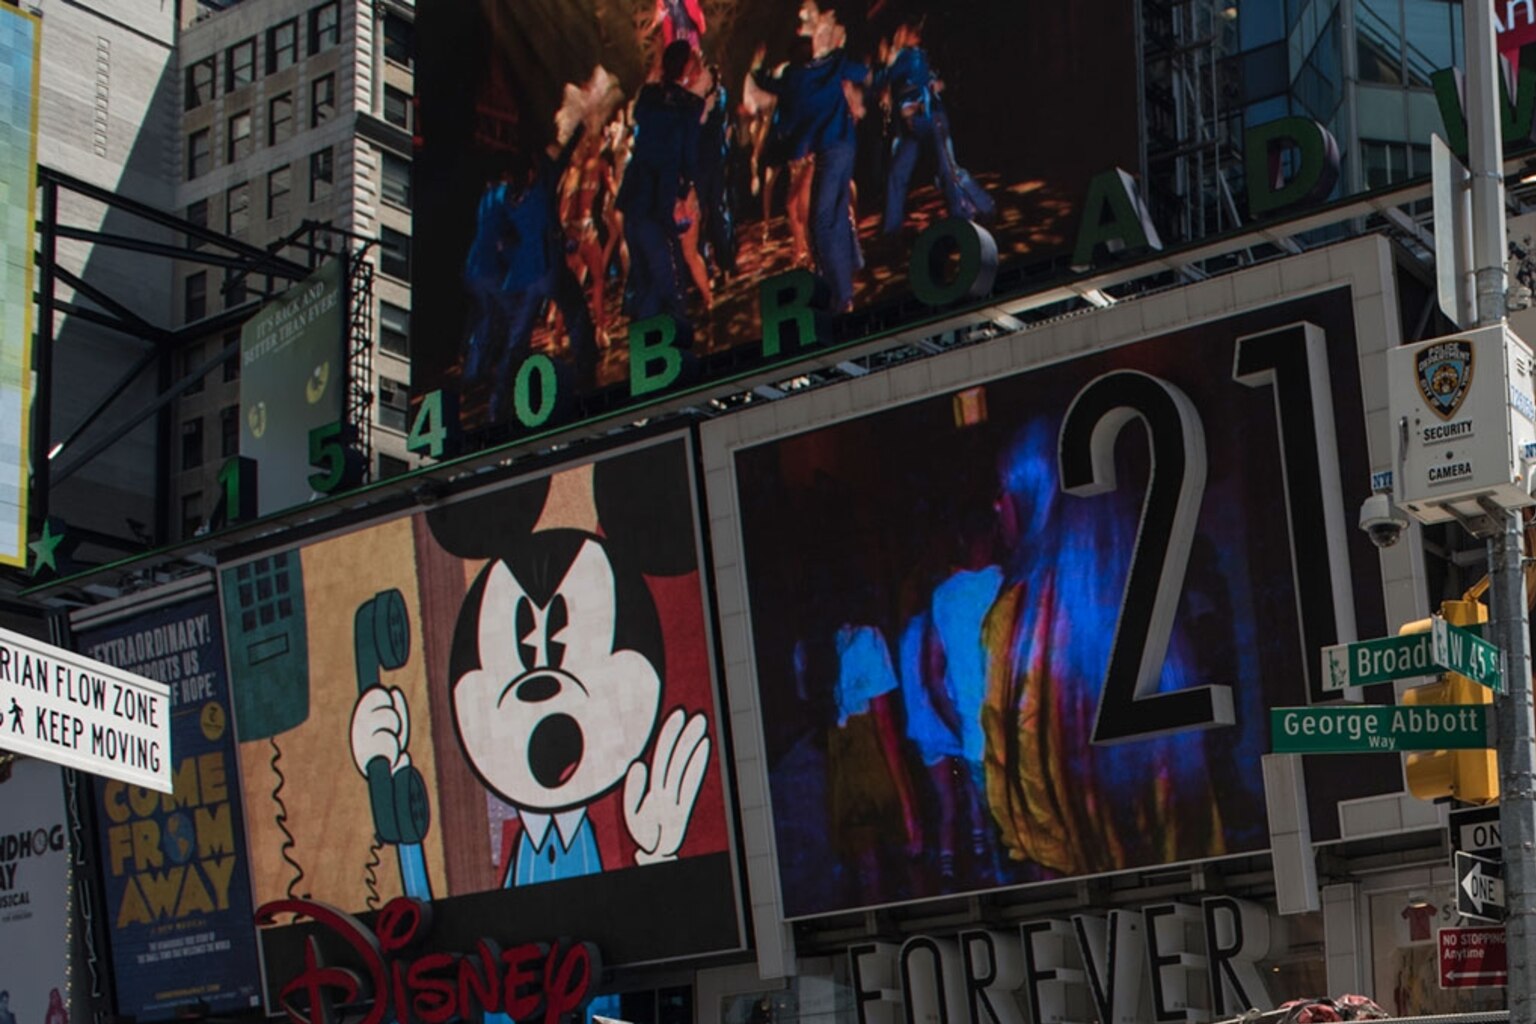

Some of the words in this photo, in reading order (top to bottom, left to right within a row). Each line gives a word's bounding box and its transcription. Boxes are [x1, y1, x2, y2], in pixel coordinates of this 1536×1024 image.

[218, 355, 557, 521] 1540
[1424, 420, 1473, 441] SECURITY
[1373, 471, 1393, 488] NY
[1428, 462, 1472, 481] CAMERA
[1058, 321, 1363, 746] 21
[183, 650, 200, 674] US
[1450, 630, 1463, 668] W
[1469, 643, 1486, 679] 45
[56, 665, 106, 711] FLOW
[113, 684, 159, 728] ZONE
[1284, 713, 1378, 740] George
[1391, 708, 1479, 733] Abbott
[36, 706, 83, 749] KEEP
[92, 723, 160, 773] MOVING
[1369, 735, 1396, 749] Way
[108, 801, 235, 877] FROM
[1473, 824, 1501, 847] ON
[117, 855, 236, 928] AWAY
[1471, 876, 1495, 901] ONE
[1443, 934, 1457, 946] NO
[1444, 949, 1485, 962] Anytime
